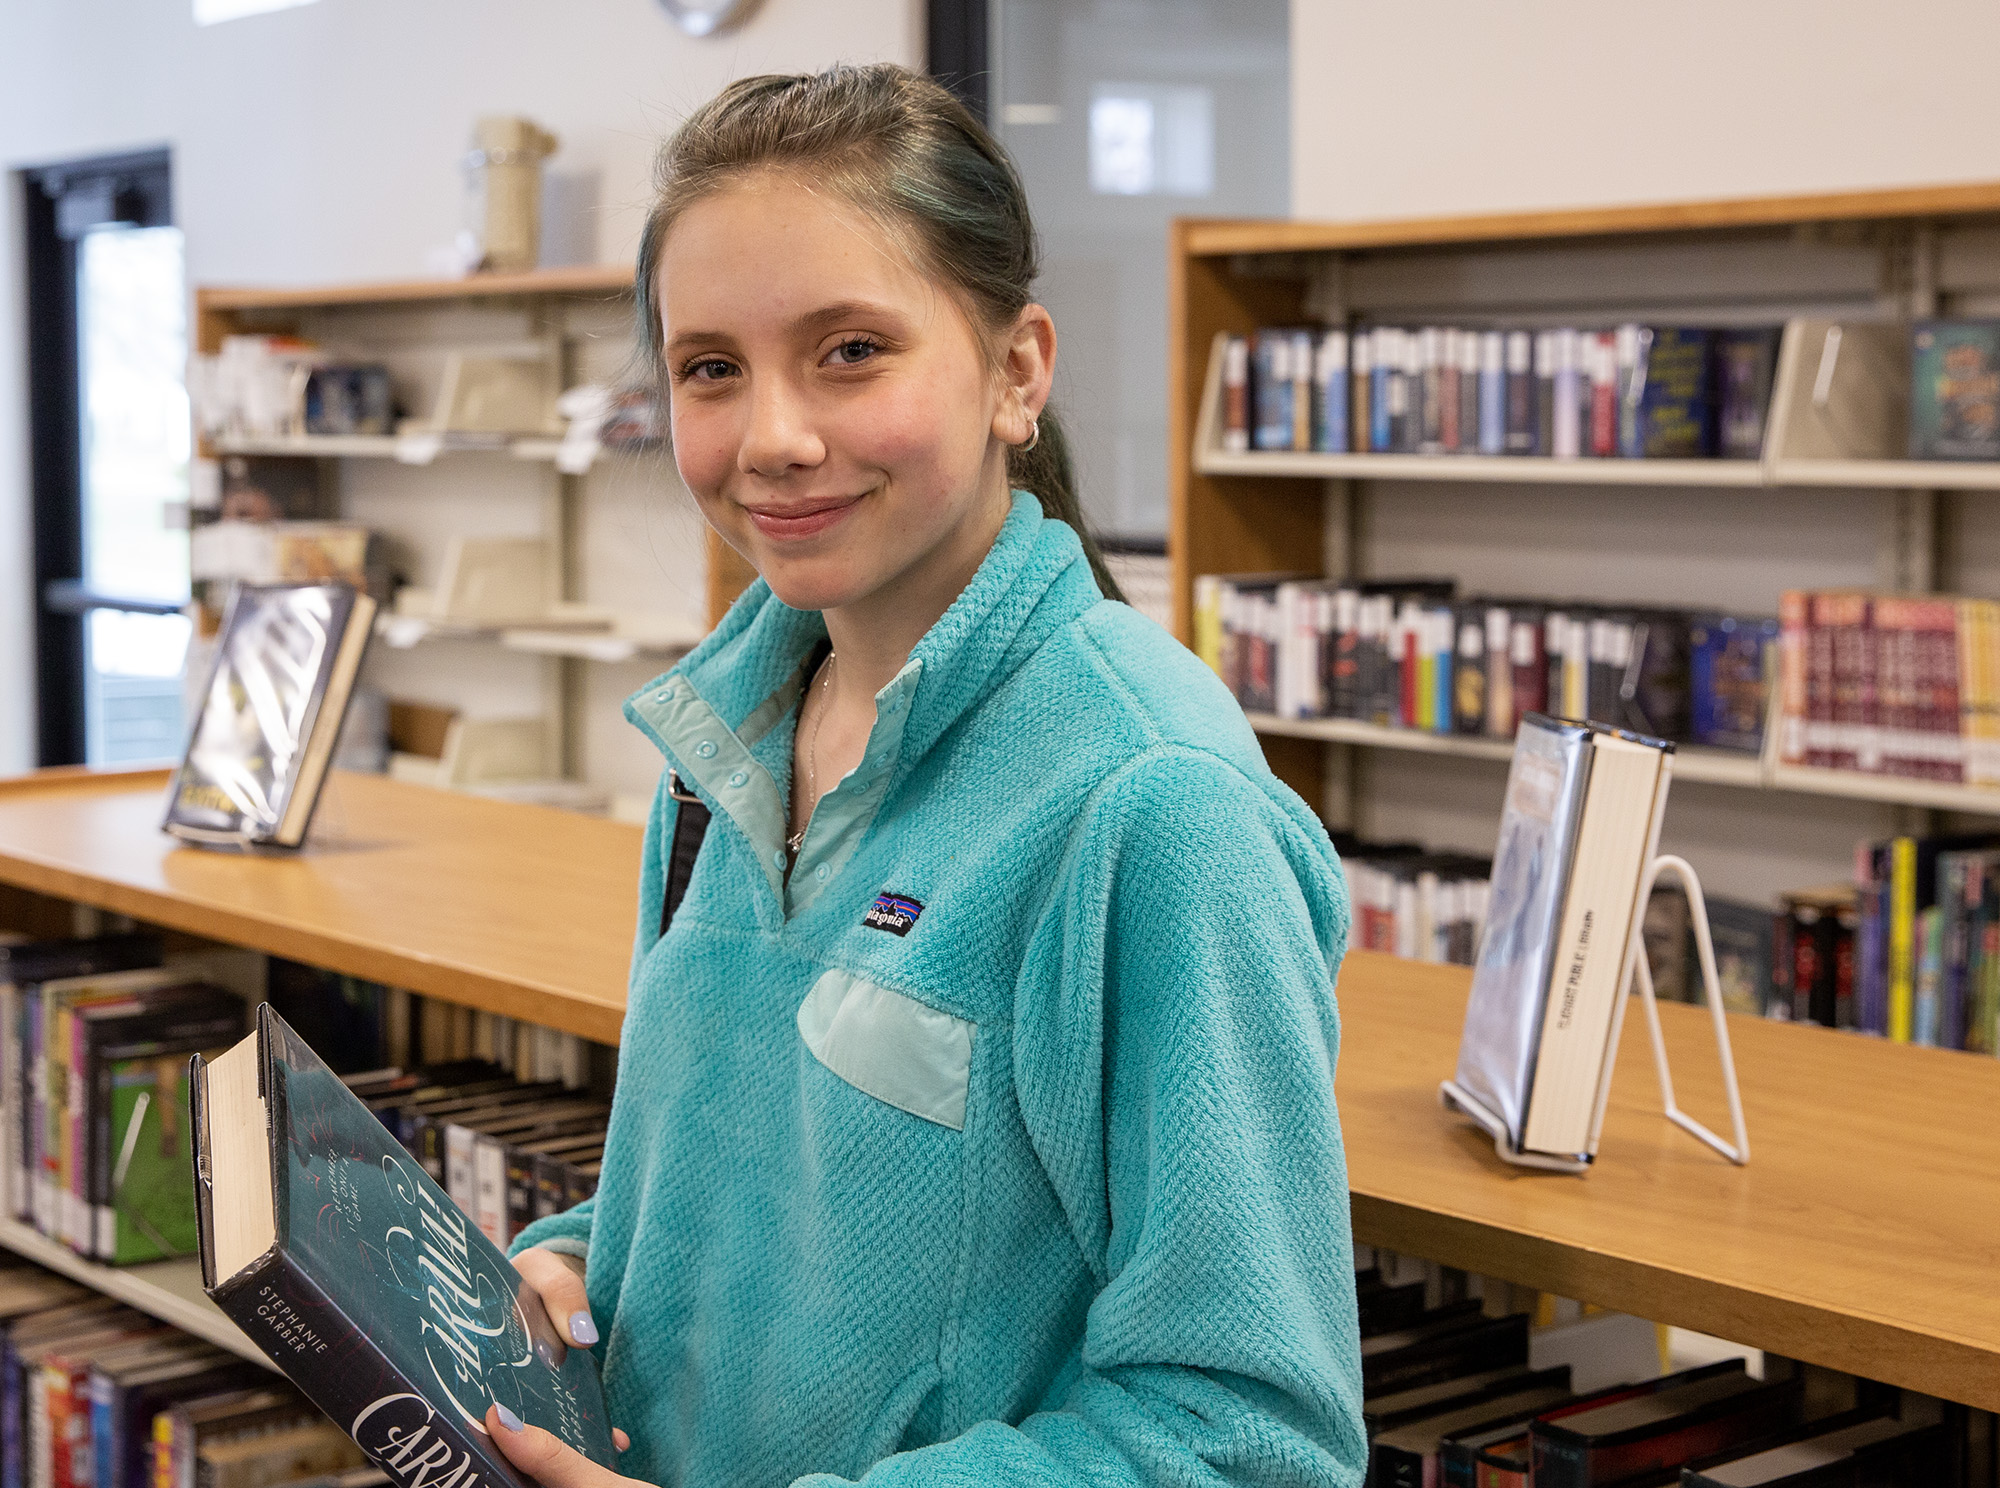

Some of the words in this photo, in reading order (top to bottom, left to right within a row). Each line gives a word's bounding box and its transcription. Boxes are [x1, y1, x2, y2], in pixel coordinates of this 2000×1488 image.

[339, 1164, 349, 1198] ONLY
[257, 1305, 306, 1353] GARBER
[258, 1286, 328, 1353] STEPHANIE
[548, 1357, 572, 1441] PHANIE
[565, 1391, 587, 1456] ARBER
[351, 1392, 490, 1488] CARA
